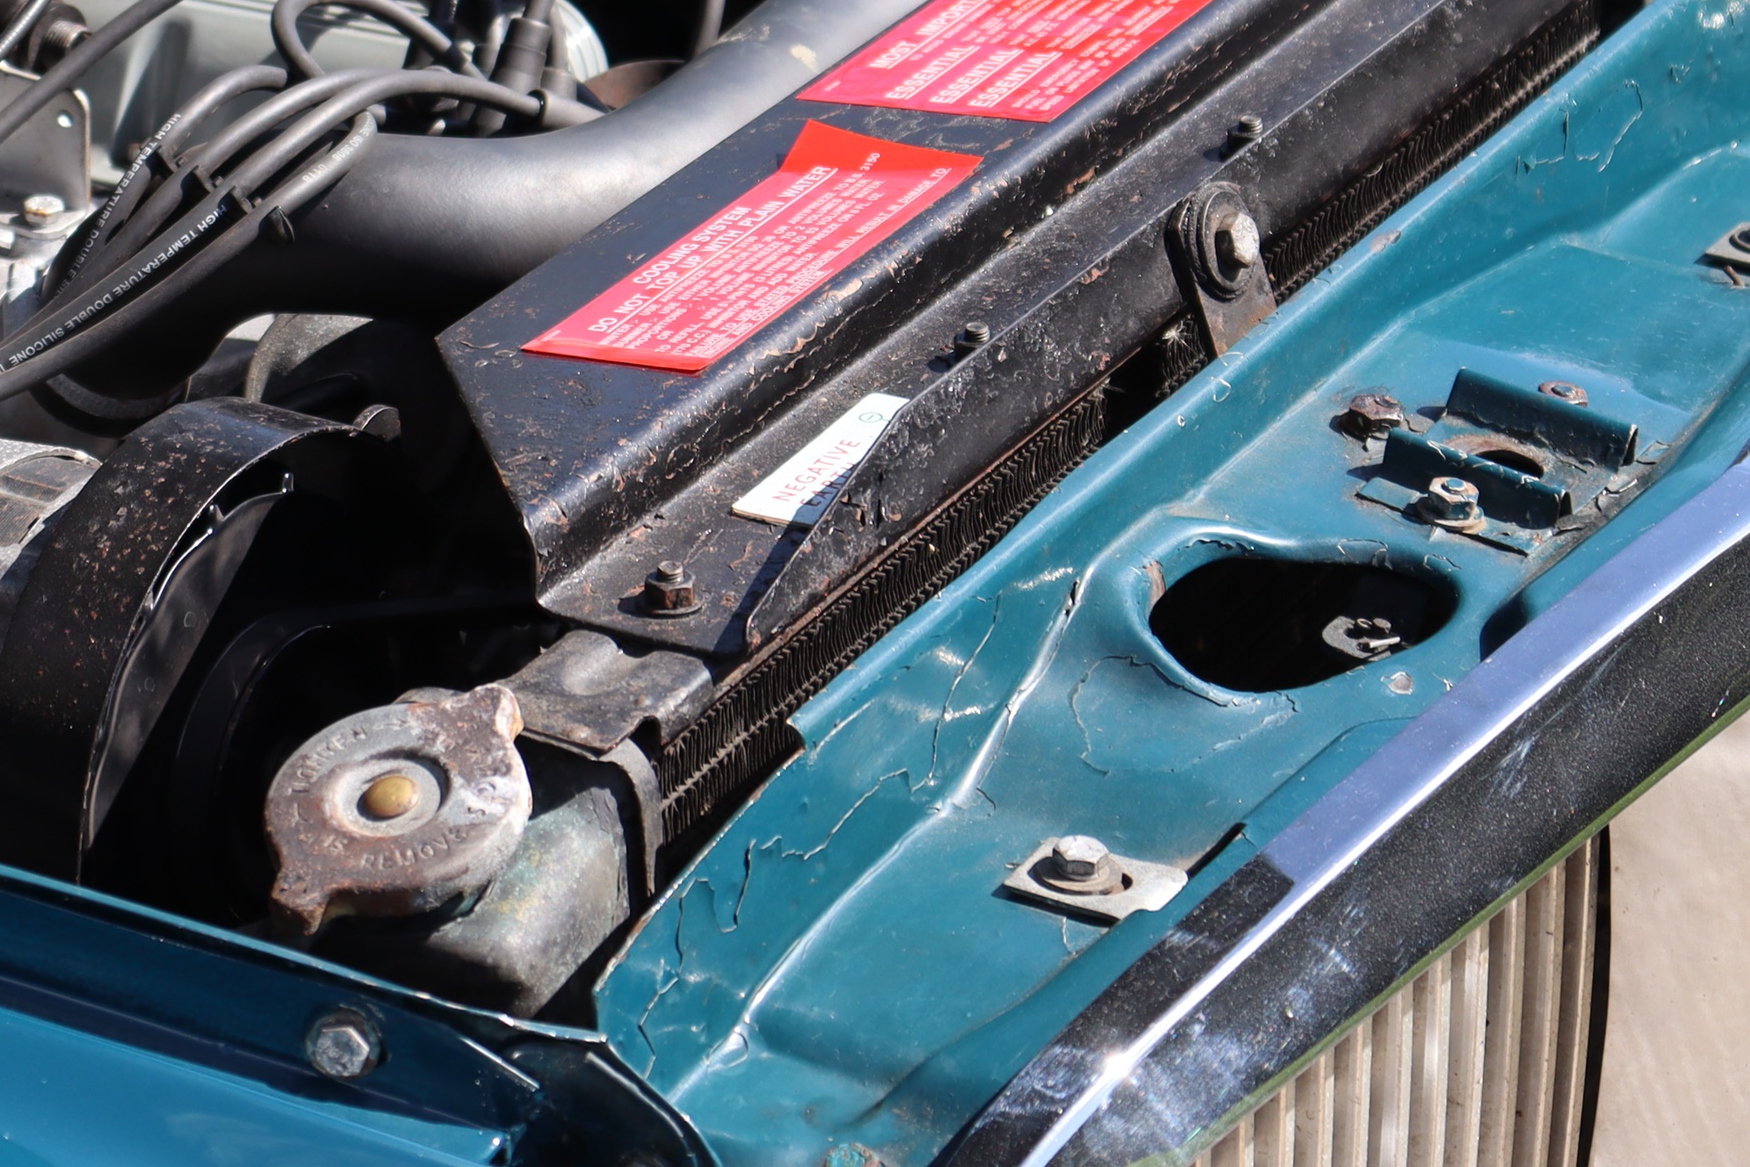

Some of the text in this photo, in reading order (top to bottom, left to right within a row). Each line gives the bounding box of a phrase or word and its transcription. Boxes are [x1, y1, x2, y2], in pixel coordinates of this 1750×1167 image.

[869, 40, 920, 68] MOST
[886, 44, 974, 99] ESSENTIAL
[930, 47, 1018, 103] ESSENTIAL
[969, 50, 1058, 106] ESSENTIAL
[69, 113, 182, 279] HIGH TEMPERATURE DOUBLE
[198, 204, 227, 232] HIGH
[112, 230, 199, 297] TEMPERATURE
[588, 165, 832, 331] DO NOT TOP UP WITH PLAIN WATER
[614, 322, 653, 347] SUMMER
[660, 301, 682, 314] USE
[679, 279, 713, 300] EITHER
[710, 252, 752, 278] INHIBITOR
[772, 225, 789, 234] OR
[786, 191, 836, 224] ANTIFREEZE
[834, 182, 849, 190] TO
[859, 151, 881, 172] 3150
[627, 308, 689, 349] PROPORTIONS
[700, 273, 737, 297] VOLUME
[734, 240, 783, 272] ANTIFREEZE
[781, 231, 796, 239] TO
[802, 198, 842, 224] VOLUMES
[631, 206, 752, 283] COOLING SYSTEM
[656, 330, 674, 339] OR
[718, 272, 755, 295] VOLUME
[752, 244, 793, 270] INHIBITOR
[790, 235, 806, 243] TO
[815, 199, 856, 225] VOLUMES
[686, 333, 722, 356] FAILURE
[720, 321, 738, 331] TO
[736, 309, 756, 319] USE
[754, 285, 788, 307] STATED
[787, 249, 837, 283] PROCEDURE
[835, 234, 858, 248] WILL
[856, 211, 890, 233] RESULT
[897, 180, 933, 203] DAMAGE
[930, 168, 948, 181] TO
[64, 292, 114, 330] DOUBLE
[599, 324, 633, 345] WINTER
[641, 303, 662, 315] USE
[660, 269, 711, 302] ANTIFREEZE
[709, 259, 724, 267] TO
[655, 344, 671, 352] TO
[701, 306, 724, 319] USE
[729, 283, 756, 299] PINTS
[793, 222, 841, 254] ANTIFREEZE
[837, 213, 854, 222] OR
[708, 299, 751, 328] INHIBITOR
[748, 286, 770, 298] AND
[767, 272, 789, 285] ADD
[731, 322, 754, 335] AND
[751, 294, 792, 321] COOLING
[8, 328, 65, 366] SILICONE
[772, 438, 861, 502] NEGATIVE
[359, 827, 469, 872] REMOVE
